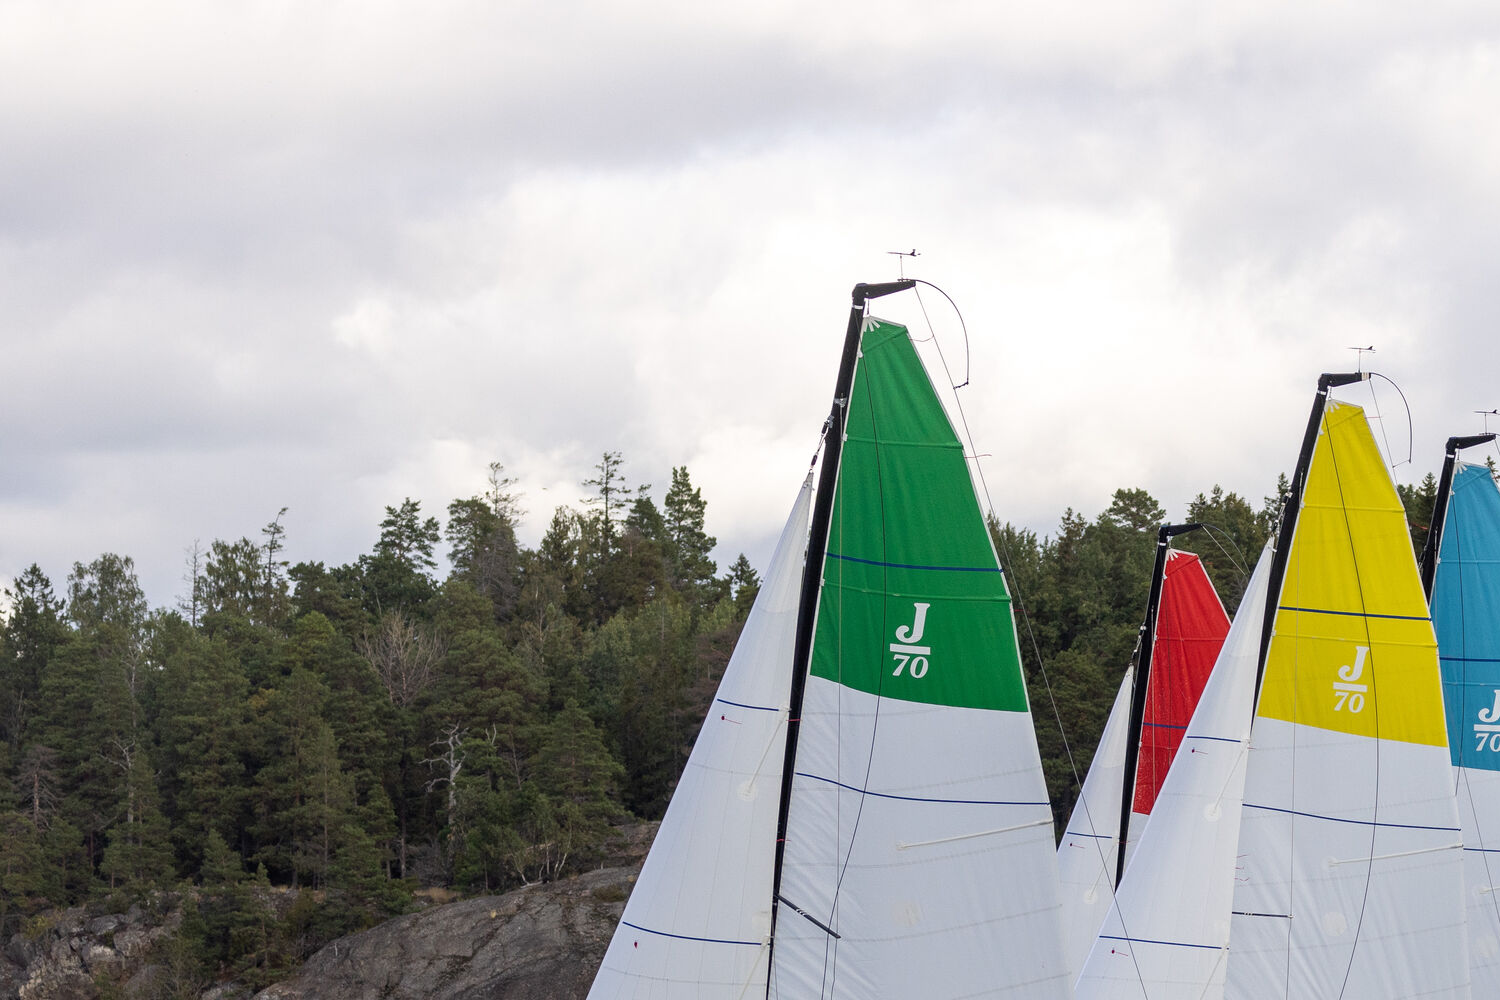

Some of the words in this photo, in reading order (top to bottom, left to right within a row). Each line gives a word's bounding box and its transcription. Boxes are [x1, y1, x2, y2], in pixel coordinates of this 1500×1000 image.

[895, 602, 930, 643] J
[892, 654, 929, 679] 70
[1337, 646, 1370, 682] J
[1334, 691, 1365, 713] 70
